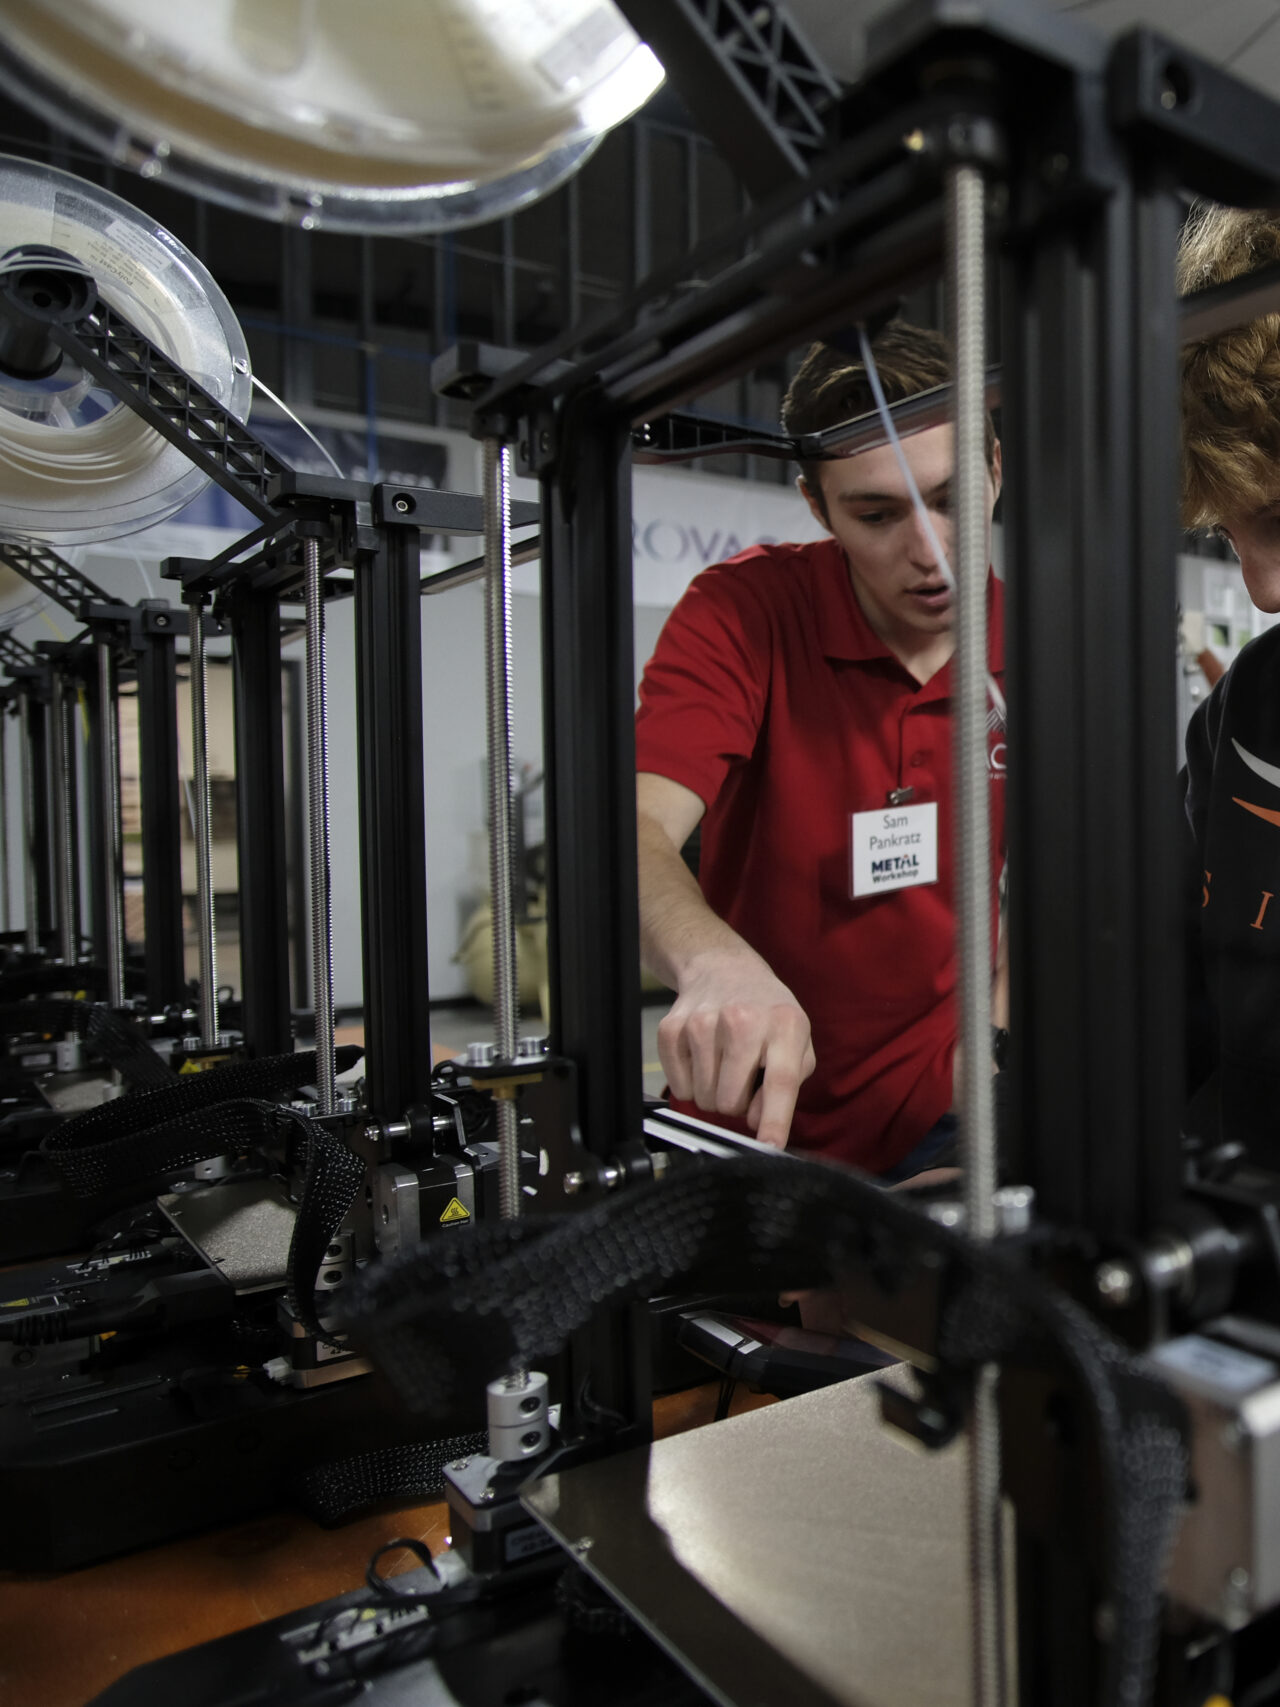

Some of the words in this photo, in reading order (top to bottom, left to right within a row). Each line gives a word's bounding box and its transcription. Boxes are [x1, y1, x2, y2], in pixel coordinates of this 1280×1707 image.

[883, 814, 909, 830] Sam
[869, 832, 922, 851] Pankratz
[871, 853, 920, 874] METAL
[872, 868, 919, 884] Workshop
